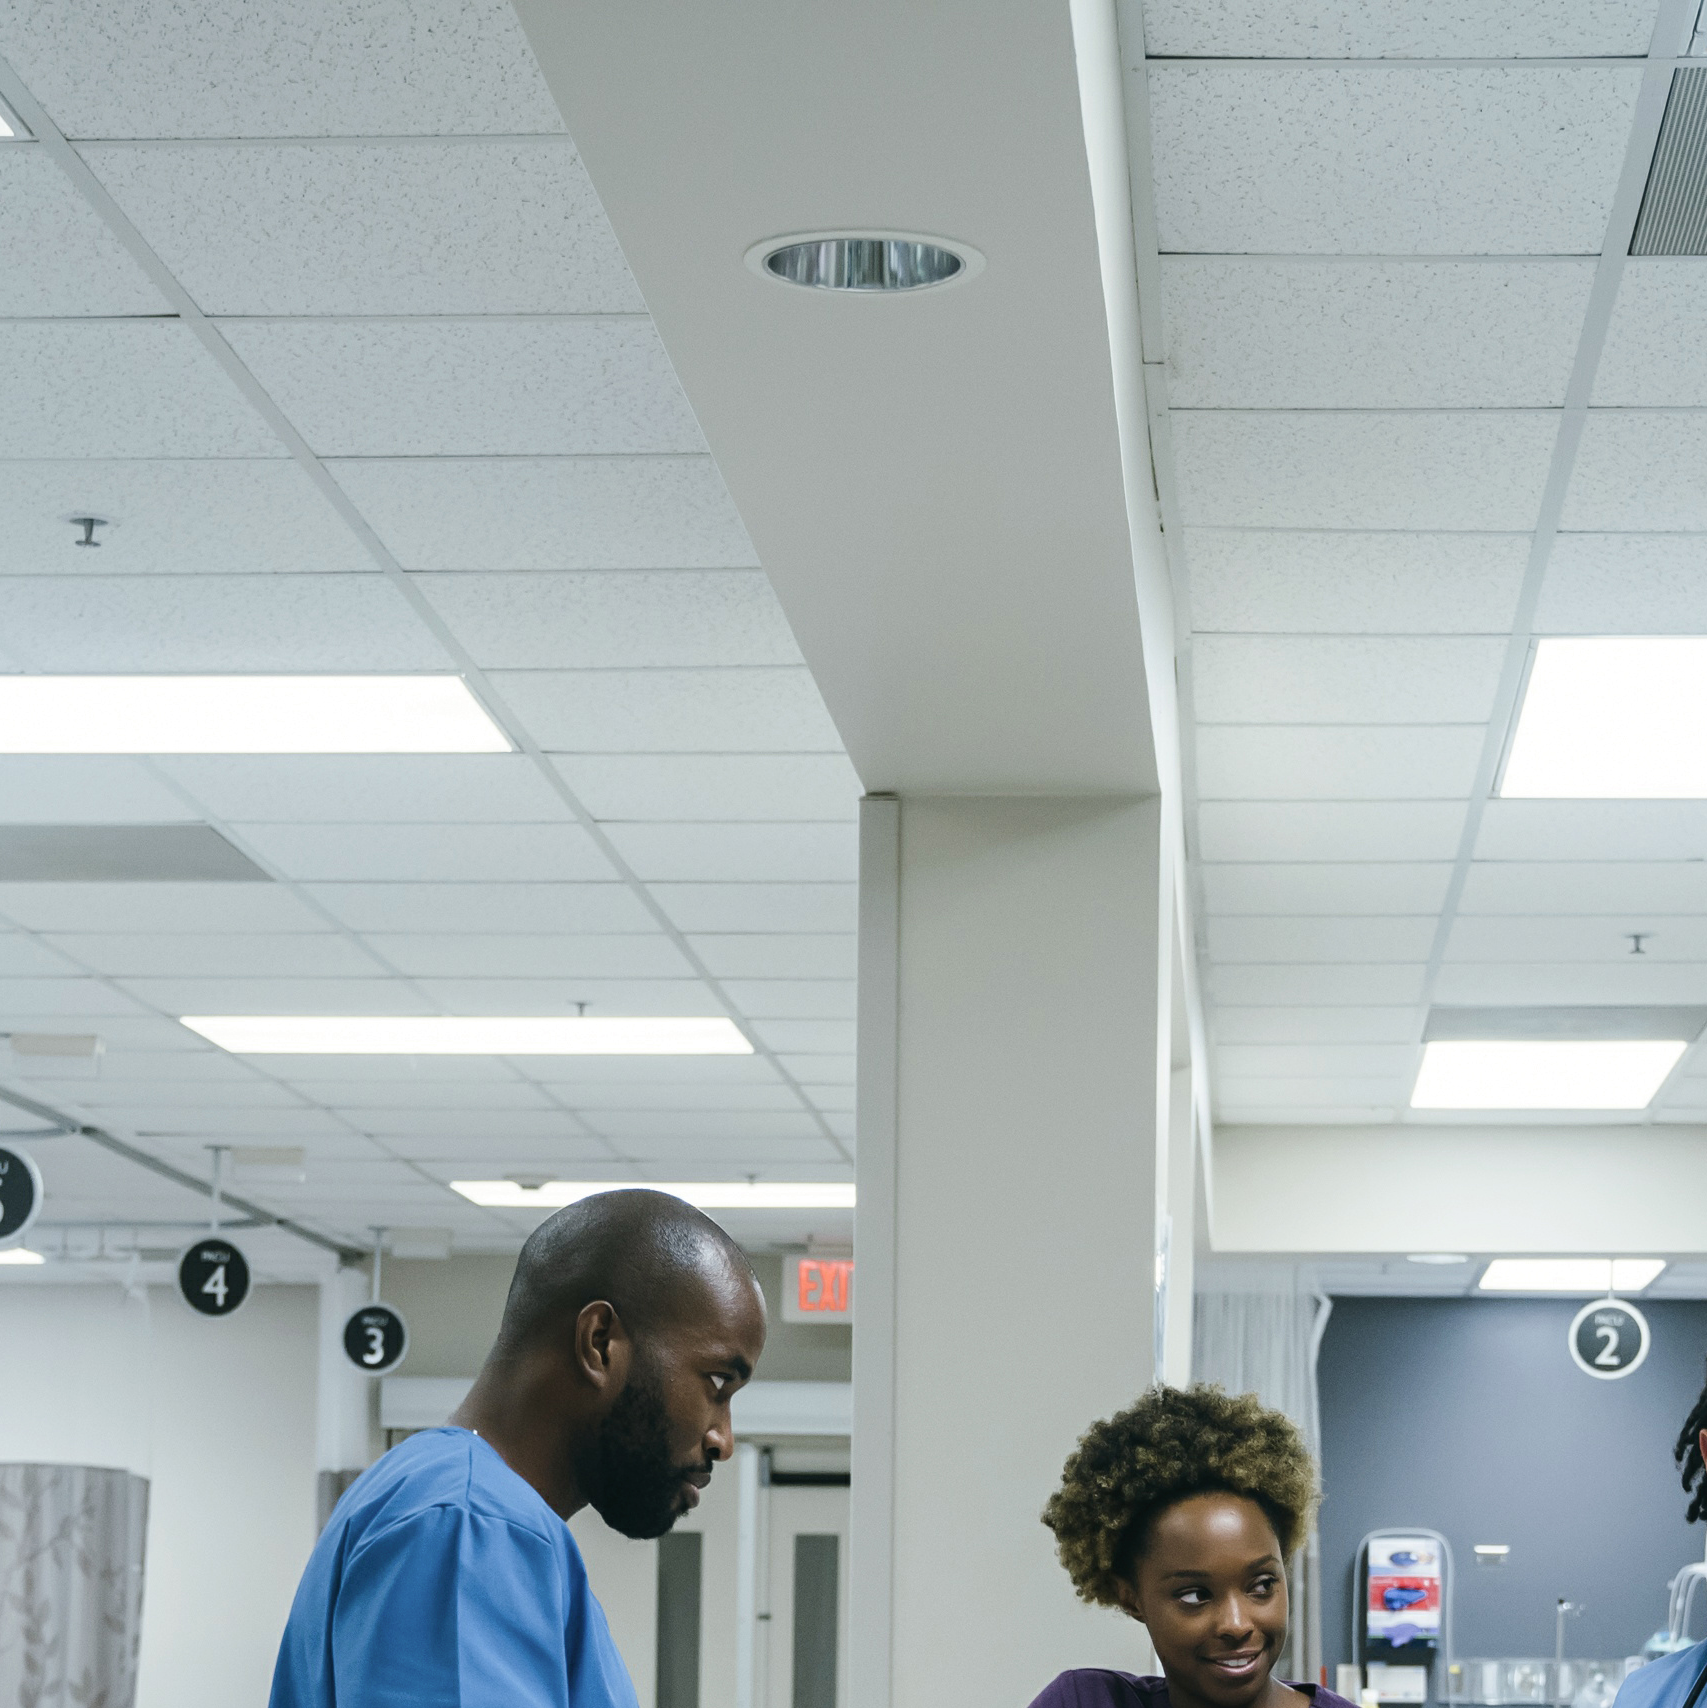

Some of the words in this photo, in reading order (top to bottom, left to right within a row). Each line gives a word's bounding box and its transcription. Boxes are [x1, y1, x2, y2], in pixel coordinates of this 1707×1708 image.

[201, 1264, 230, 1308] 4
[362, 1327, 385, 1365] 3
[1594, 1326, 1622, 1366] 2
